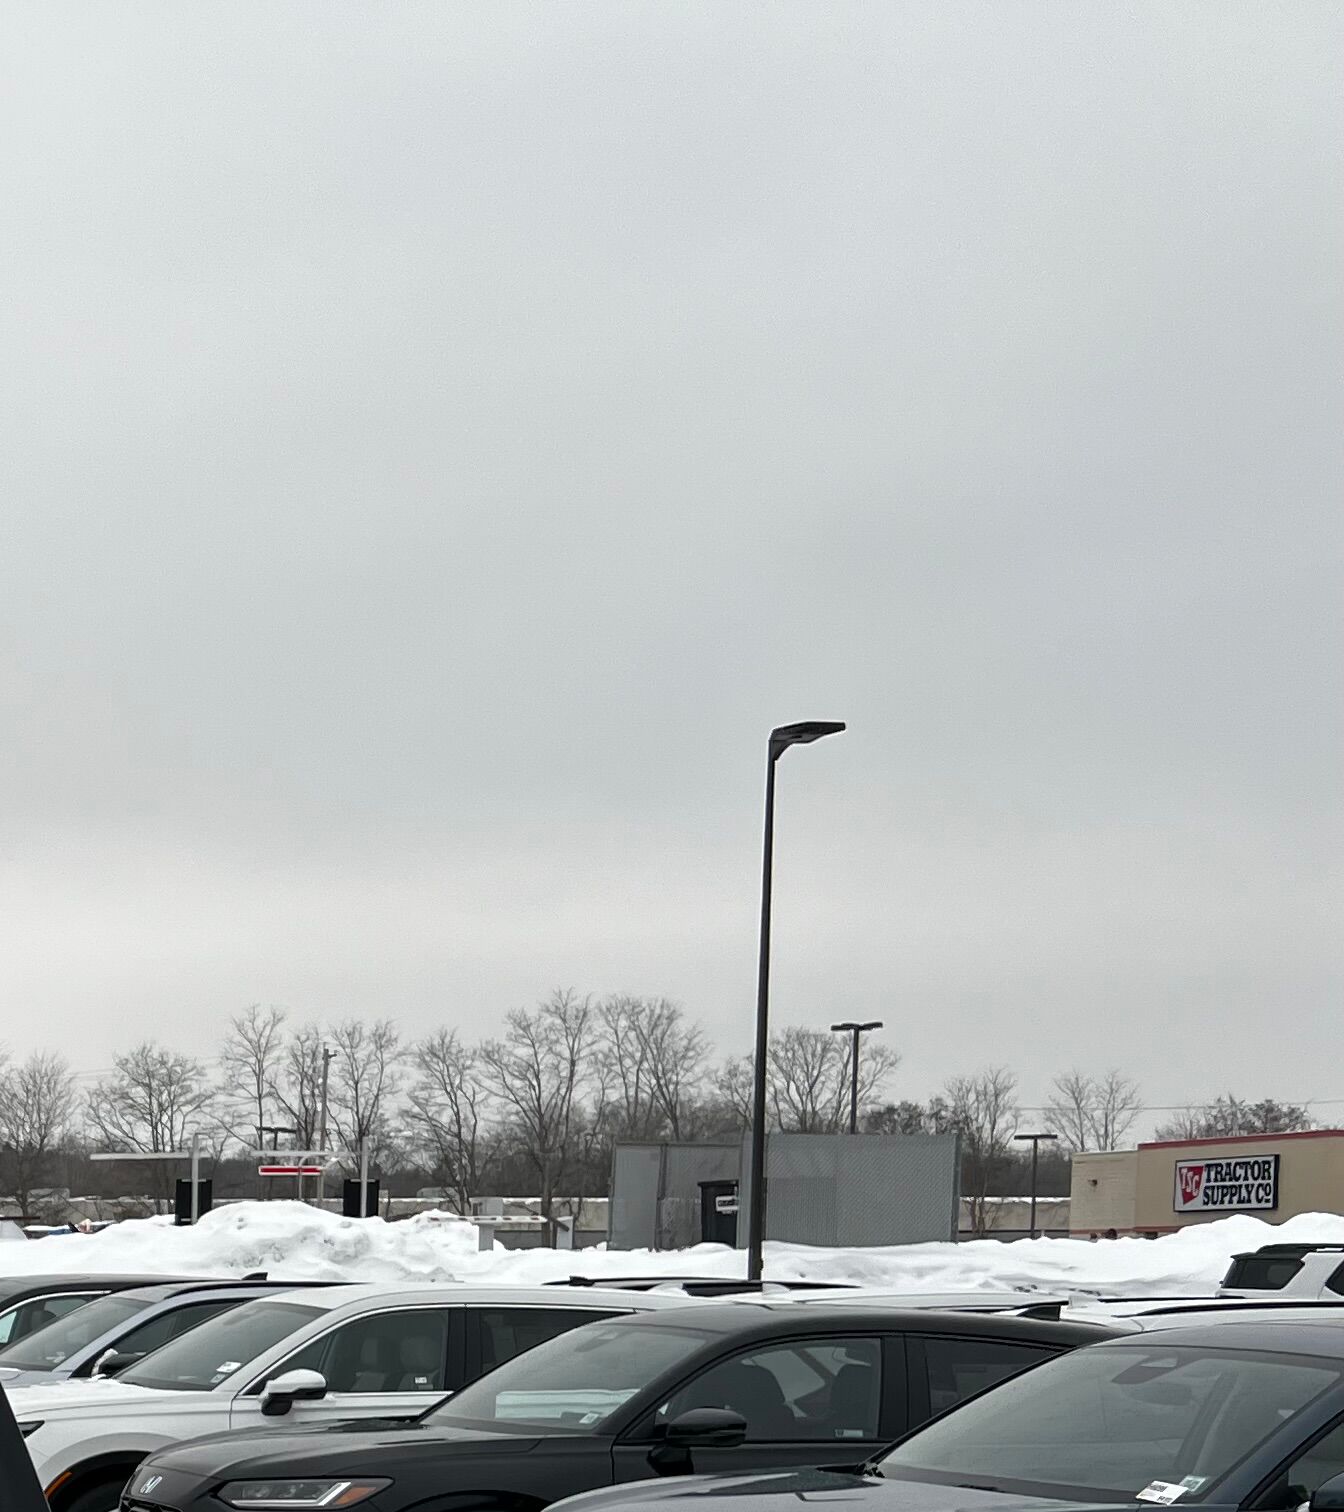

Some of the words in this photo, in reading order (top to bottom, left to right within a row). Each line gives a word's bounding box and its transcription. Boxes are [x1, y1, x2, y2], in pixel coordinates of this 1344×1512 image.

[1180, 1167, 1200, 1197] TSC
[1204, 1160, 1272, 1184] TRACTOR
[1202, 1184, 1255, 1206] SUPPLY
